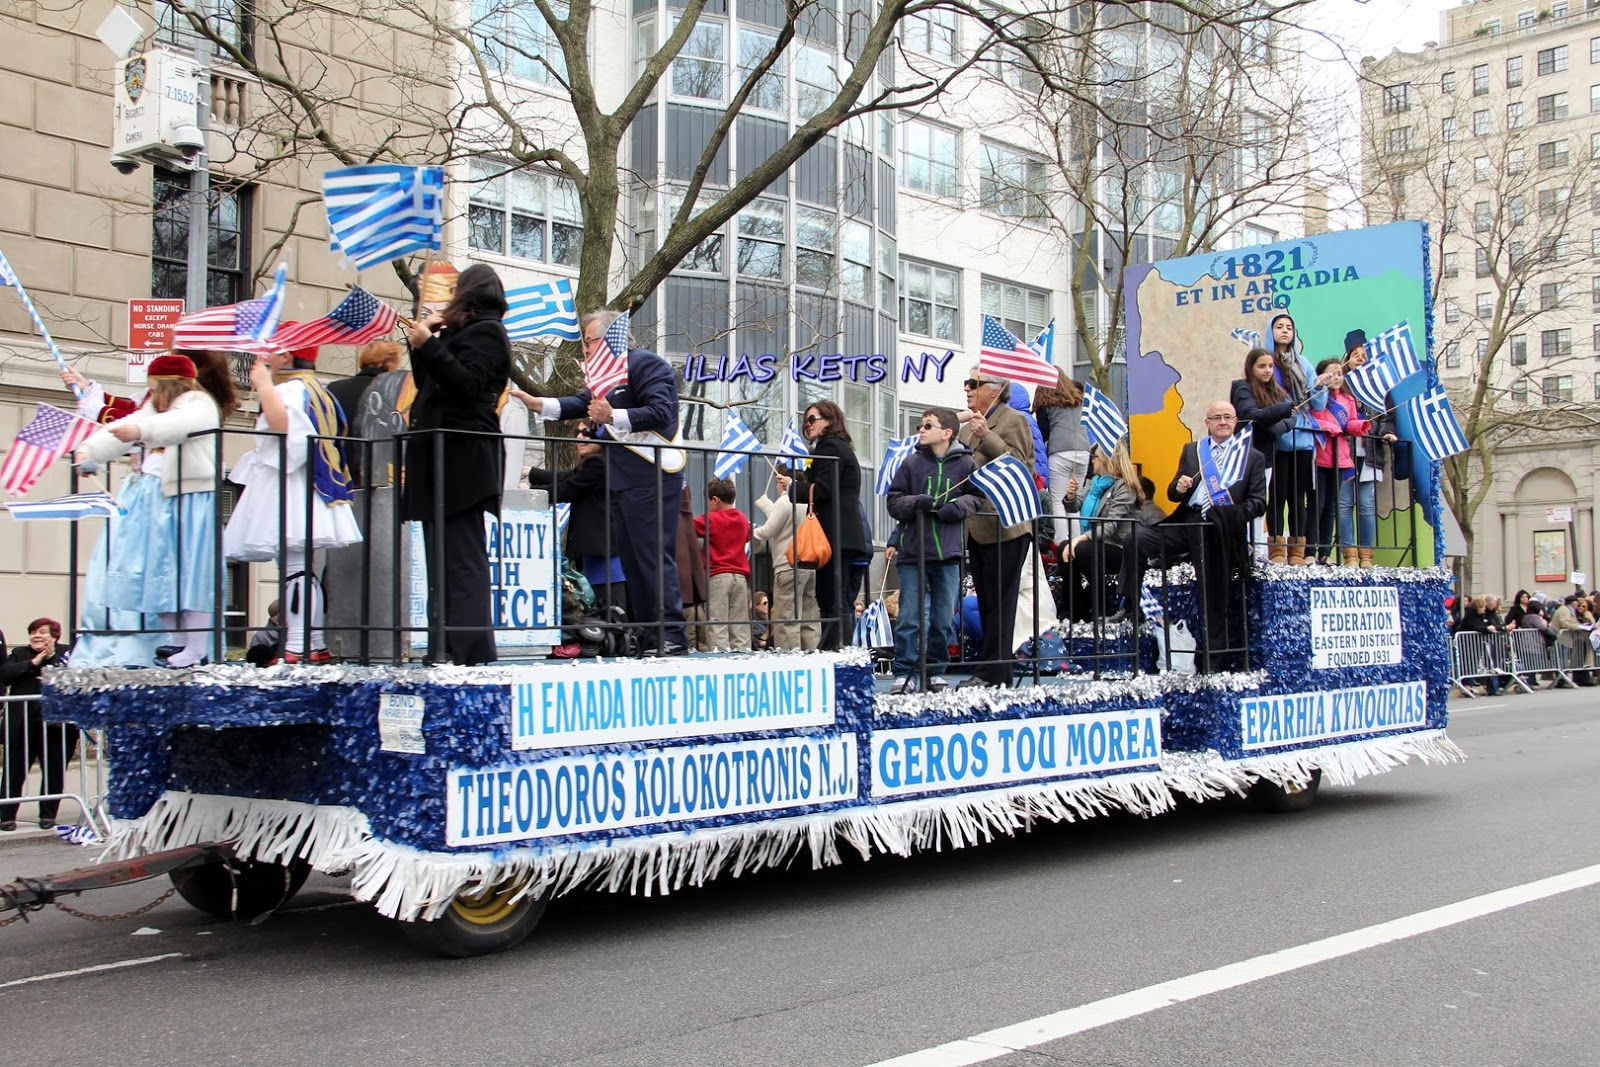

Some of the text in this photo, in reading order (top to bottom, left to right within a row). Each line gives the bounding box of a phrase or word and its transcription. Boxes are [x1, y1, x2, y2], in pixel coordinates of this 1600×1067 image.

[1224, 246, 1304, 281] 1821
[1175, 265, 1360, 306] ET IN ARCADIA
[133, 305, 180, 313] NO STANDING
[1240, 294, 1291, 314] EGO
[488, 522, 546, 559] ARITY
[489, 562, 520, 586] TH
[491, 589, 547, 628] ECE
[1321, 612, 1393, 632] FEDERATION
[1314, 633, 1400, 650] EASTERN DISTRICT
[1327, 650, 1390, 666] FOUNDED 1931
[390, 695, 415, 707] BOND
[1246, 684, 1425, 744] EPARHIA KYNOURIAS
[878, 716, 1158, 788] GEROS TOU MOREA
[457, 741, 854, 838] THEODOROS KOLOKOTRONIS N.J.
